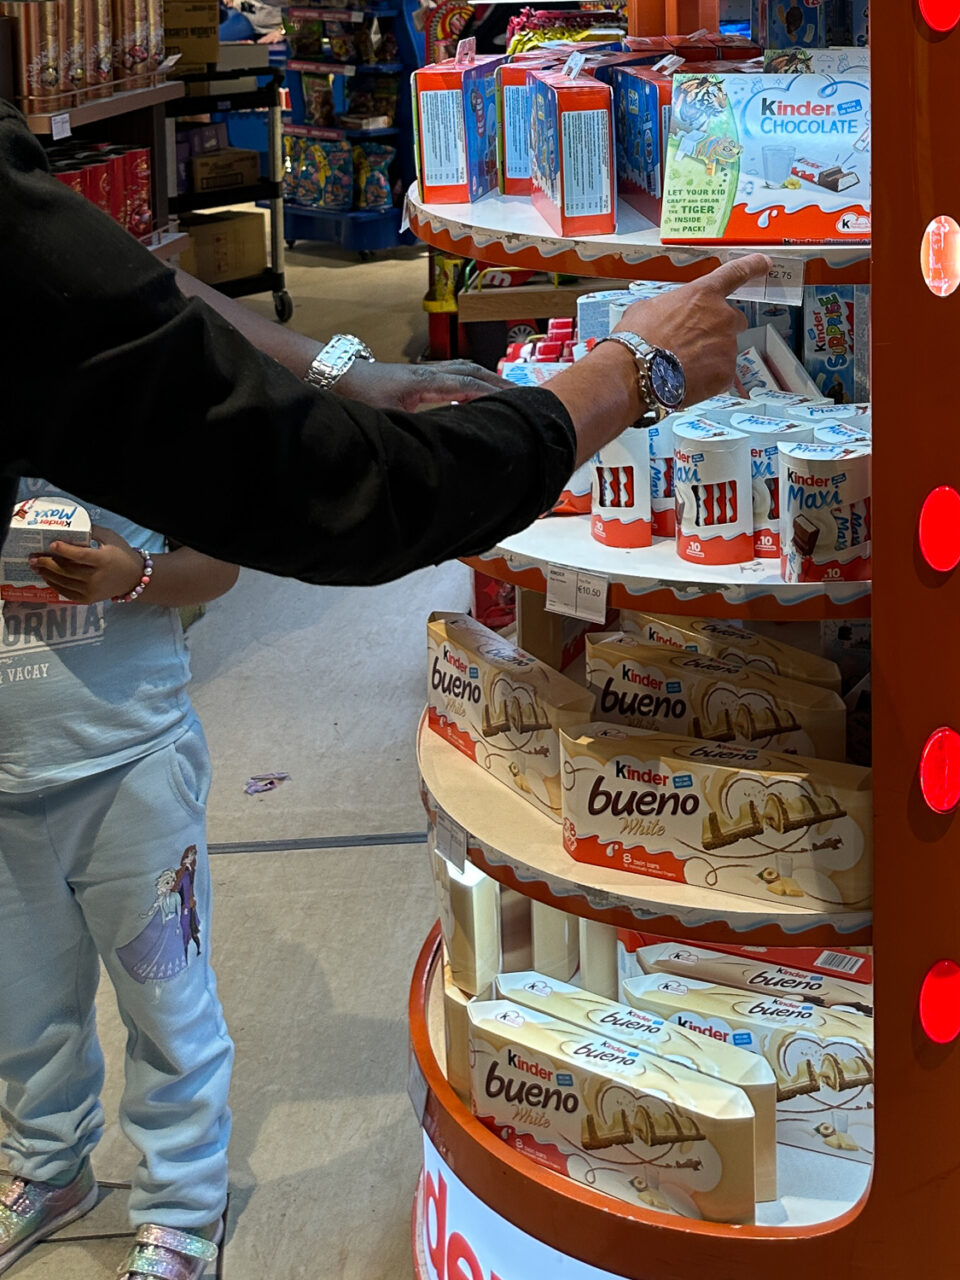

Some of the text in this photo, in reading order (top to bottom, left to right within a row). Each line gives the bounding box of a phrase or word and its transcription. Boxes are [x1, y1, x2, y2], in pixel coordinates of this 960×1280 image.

[681, 206, 715, 214] TIGER
[786, 484, 843, 513] Maxi
[7, 663, 50, 681] VACAY
[431, 656, 482, 705] bueno
[600, 677, 687, 719] bueno
[689, 746, 758, 761] bueno
[587, 775, 700, 817] bueno
[618, 816, 666, 837] White
[748, 971, 823, 991] bueno
[748, 1001, 813, 1020] bueno
[600, 1012, 661, 1034] bueno
[573, 1042, 636, 1067] bueno
[485, 1060, 580, 1115] bueno
